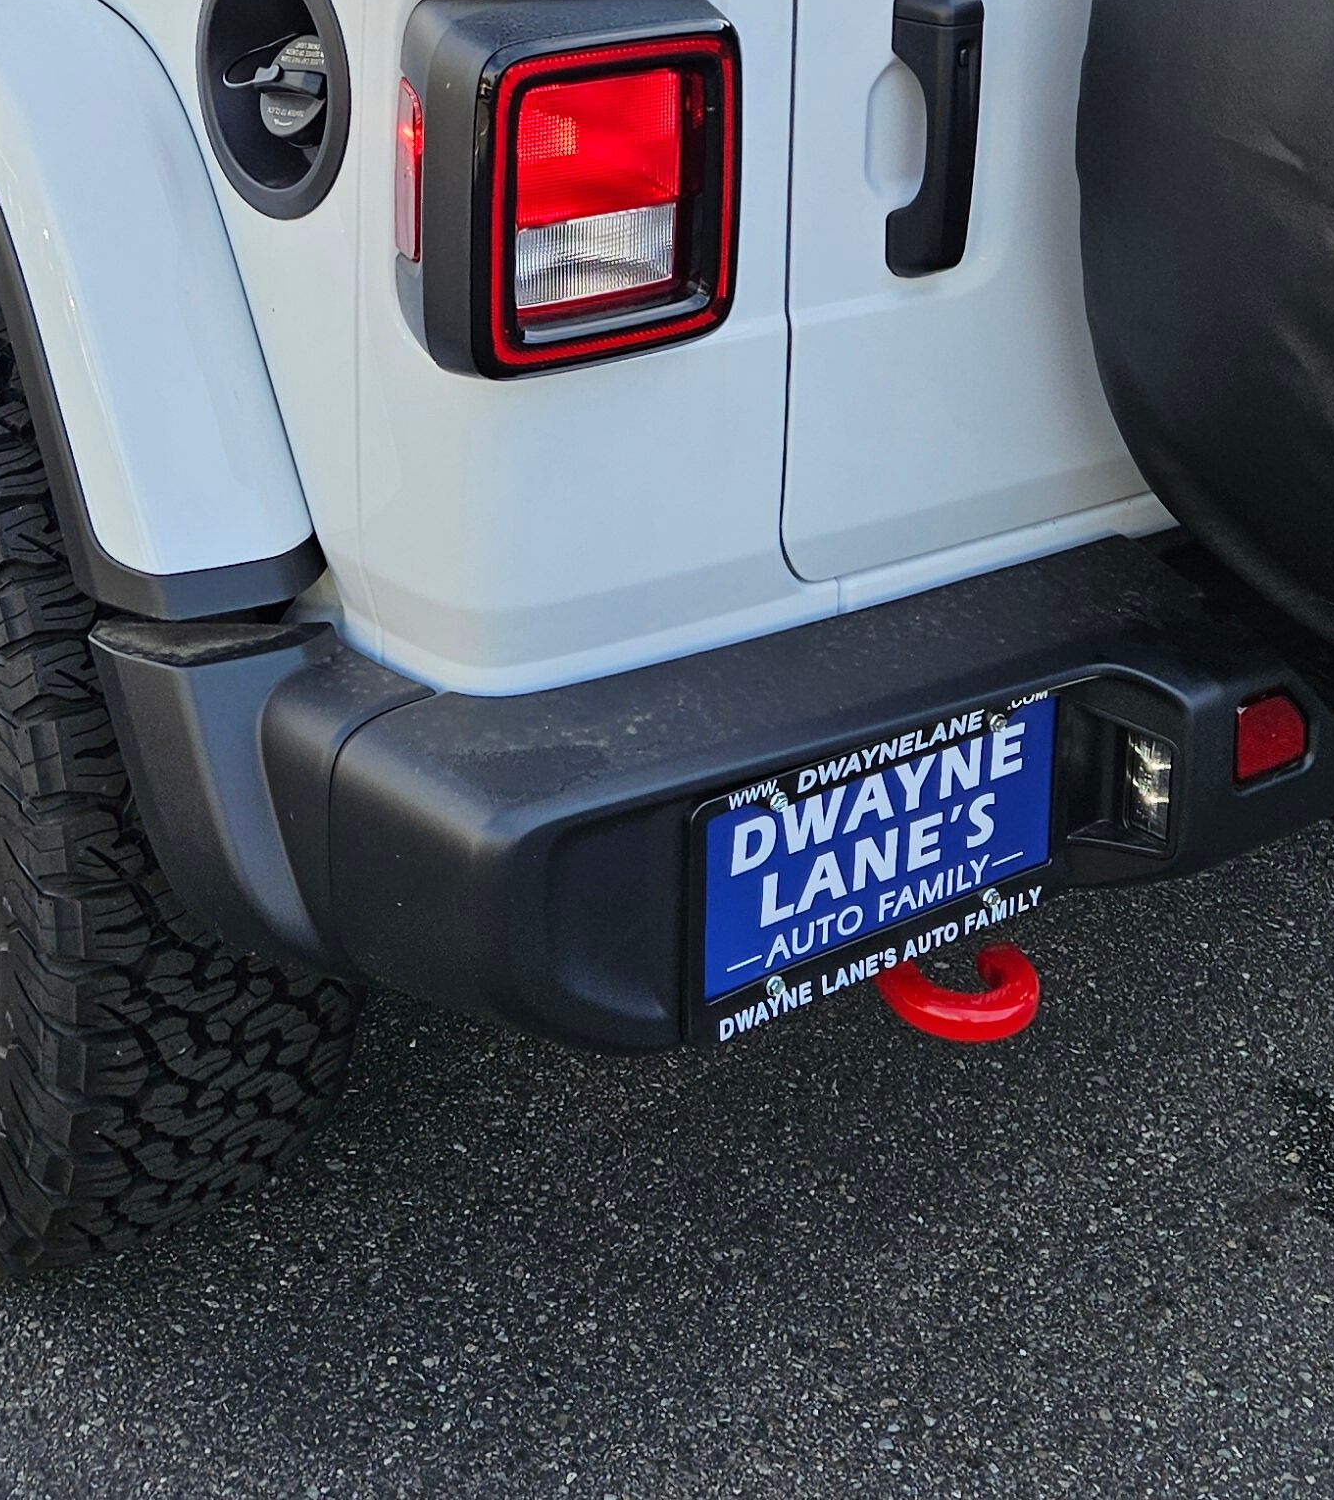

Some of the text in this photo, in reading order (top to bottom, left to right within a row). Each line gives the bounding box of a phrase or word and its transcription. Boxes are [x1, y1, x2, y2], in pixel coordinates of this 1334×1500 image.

[730, 722, 1026, 877] DWAYNE
[796, 709, 985, 794] DWAYNELANE
[760, 792, 996, 928] LANE'S
[765, 853, 992, 968] AUTO FAMILY
[719, 885, 1043, 1042] DWAYNE LANE'S AUTO FAMILY
